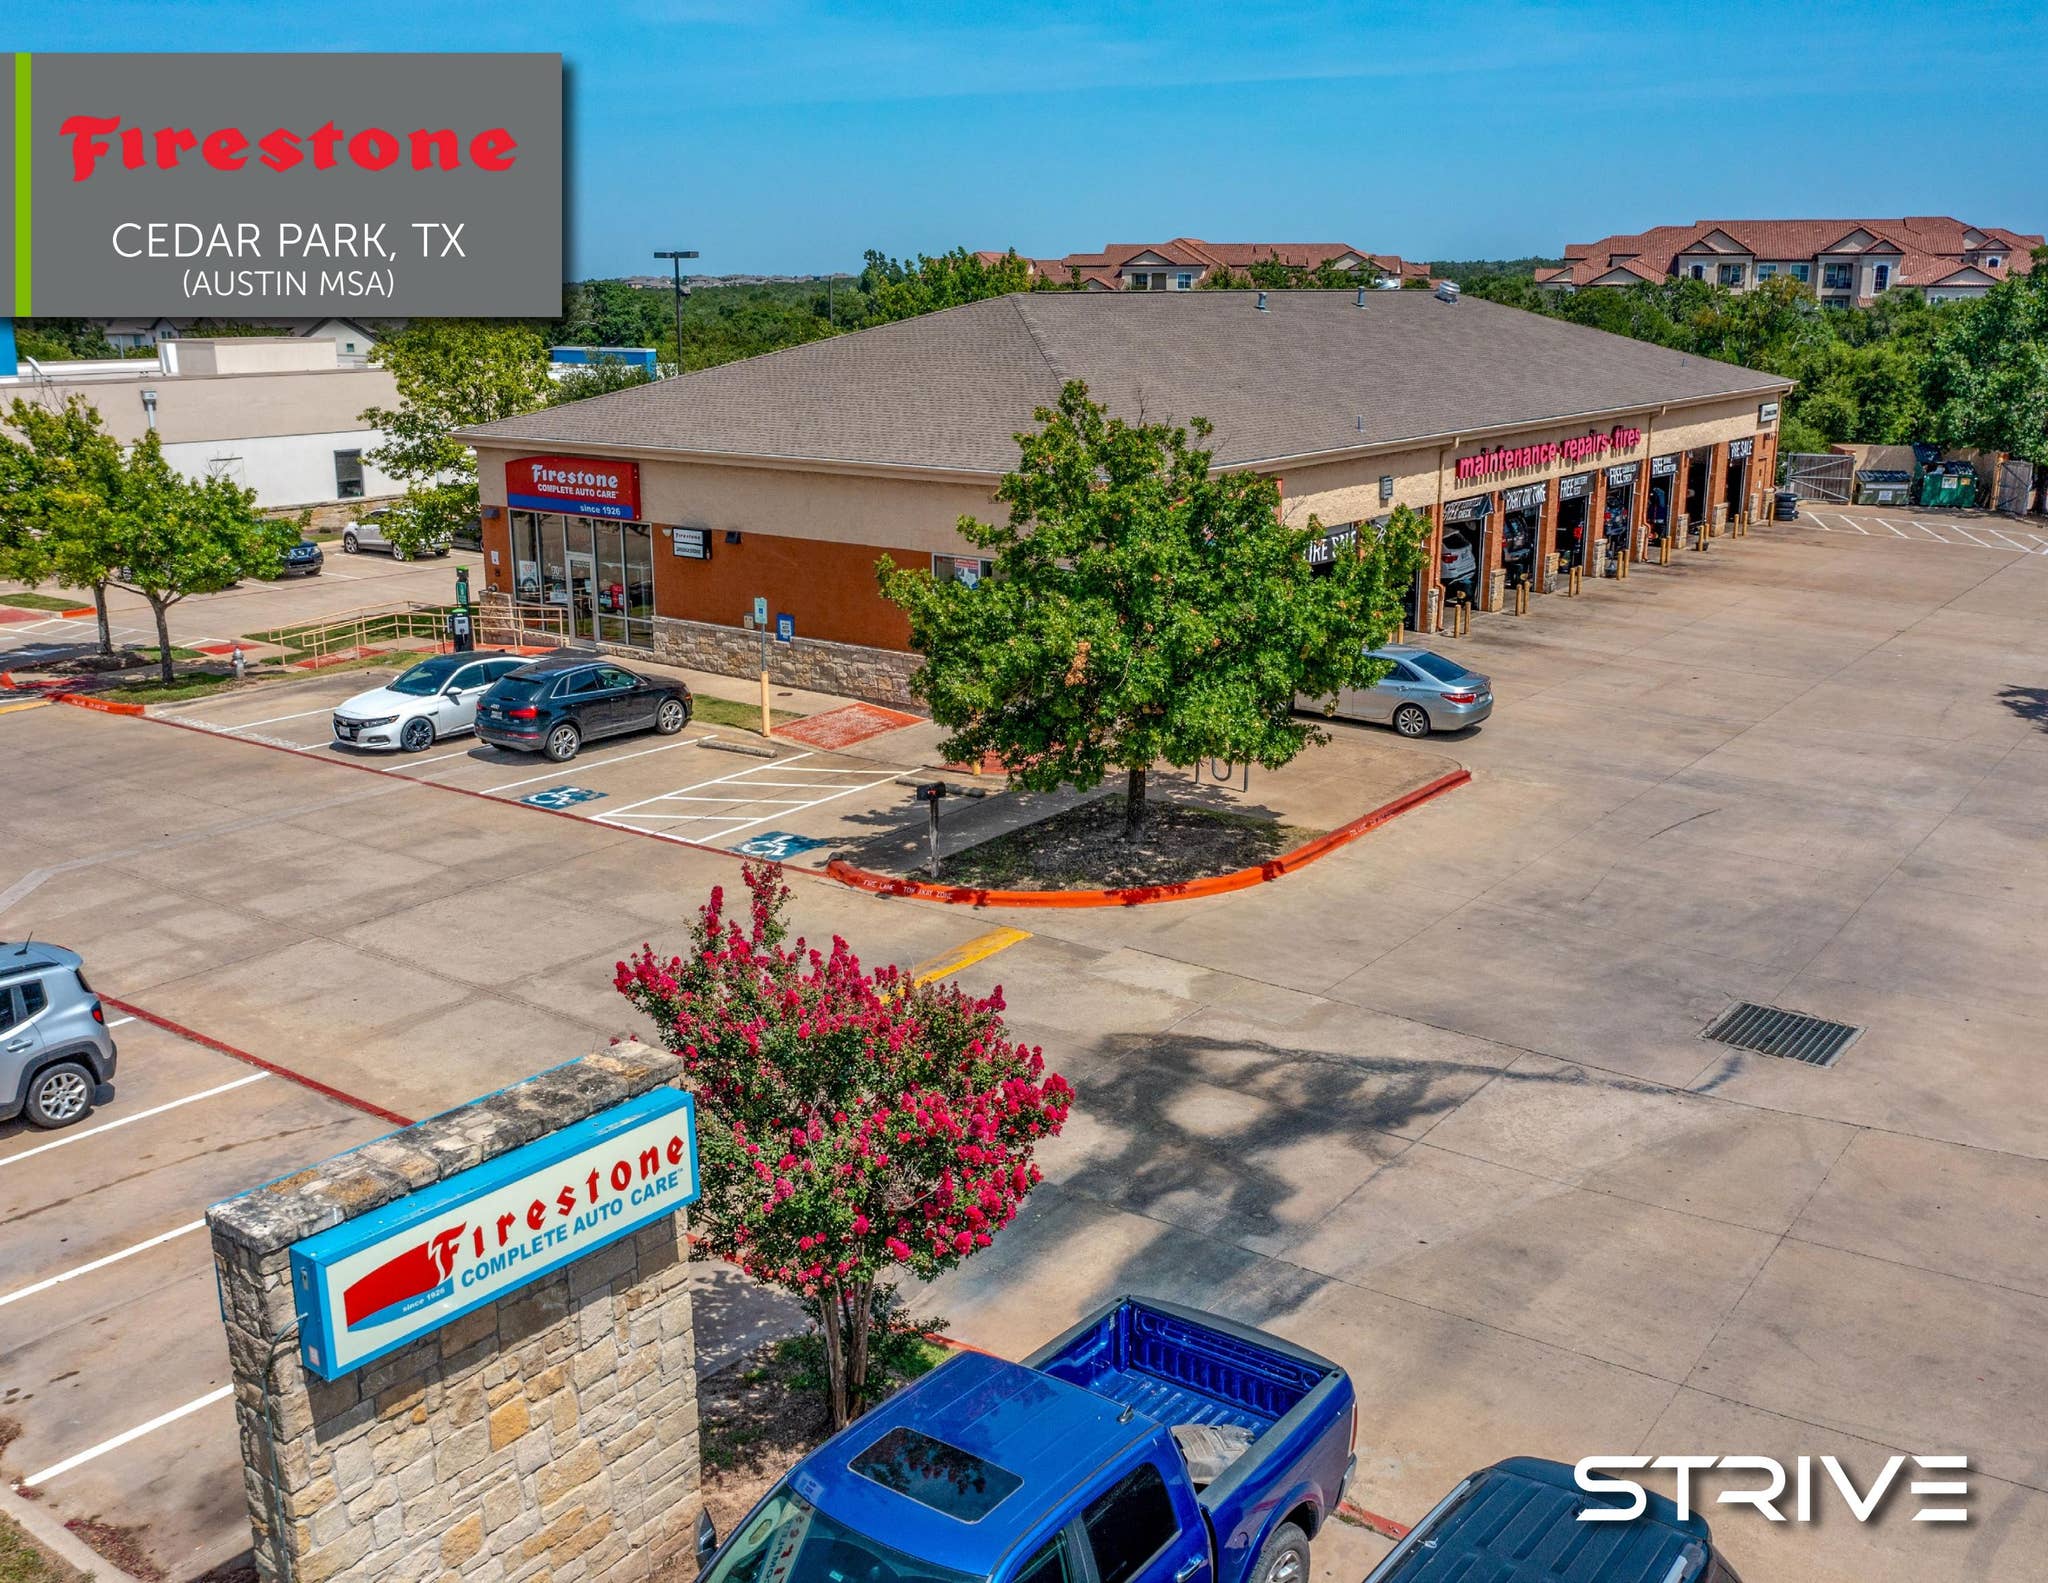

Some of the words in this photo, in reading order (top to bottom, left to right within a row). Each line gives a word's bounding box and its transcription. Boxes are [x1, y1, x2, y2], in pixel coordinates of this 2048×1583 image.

[1457, 442, 1557, 479] maintenance
[1562, 431, 1608, 462] repairs
[1612, 427, 1641, 449] tires
[531, 464, 618, 489] Firestone
[1610, 467, 1623, 486] FREE
[538, 483, 574, 495] COMPLETE
[575, 488, 595, 497] AUTO
[596, 490, 617, 499] CARE
[1561, 478, 1574, 499] FREE
[580, 504, 600, 513] since
[602, 506, 621, 516] 1926
[432, 1135, 684, 1280] Firestone
[461, 1223, 568, 1287] COMPLETE
[573, 1198, 623, 1235] AUTO
[630, 1170, 679, 1206] CARE
[402, 1298, 425, 1312] since
